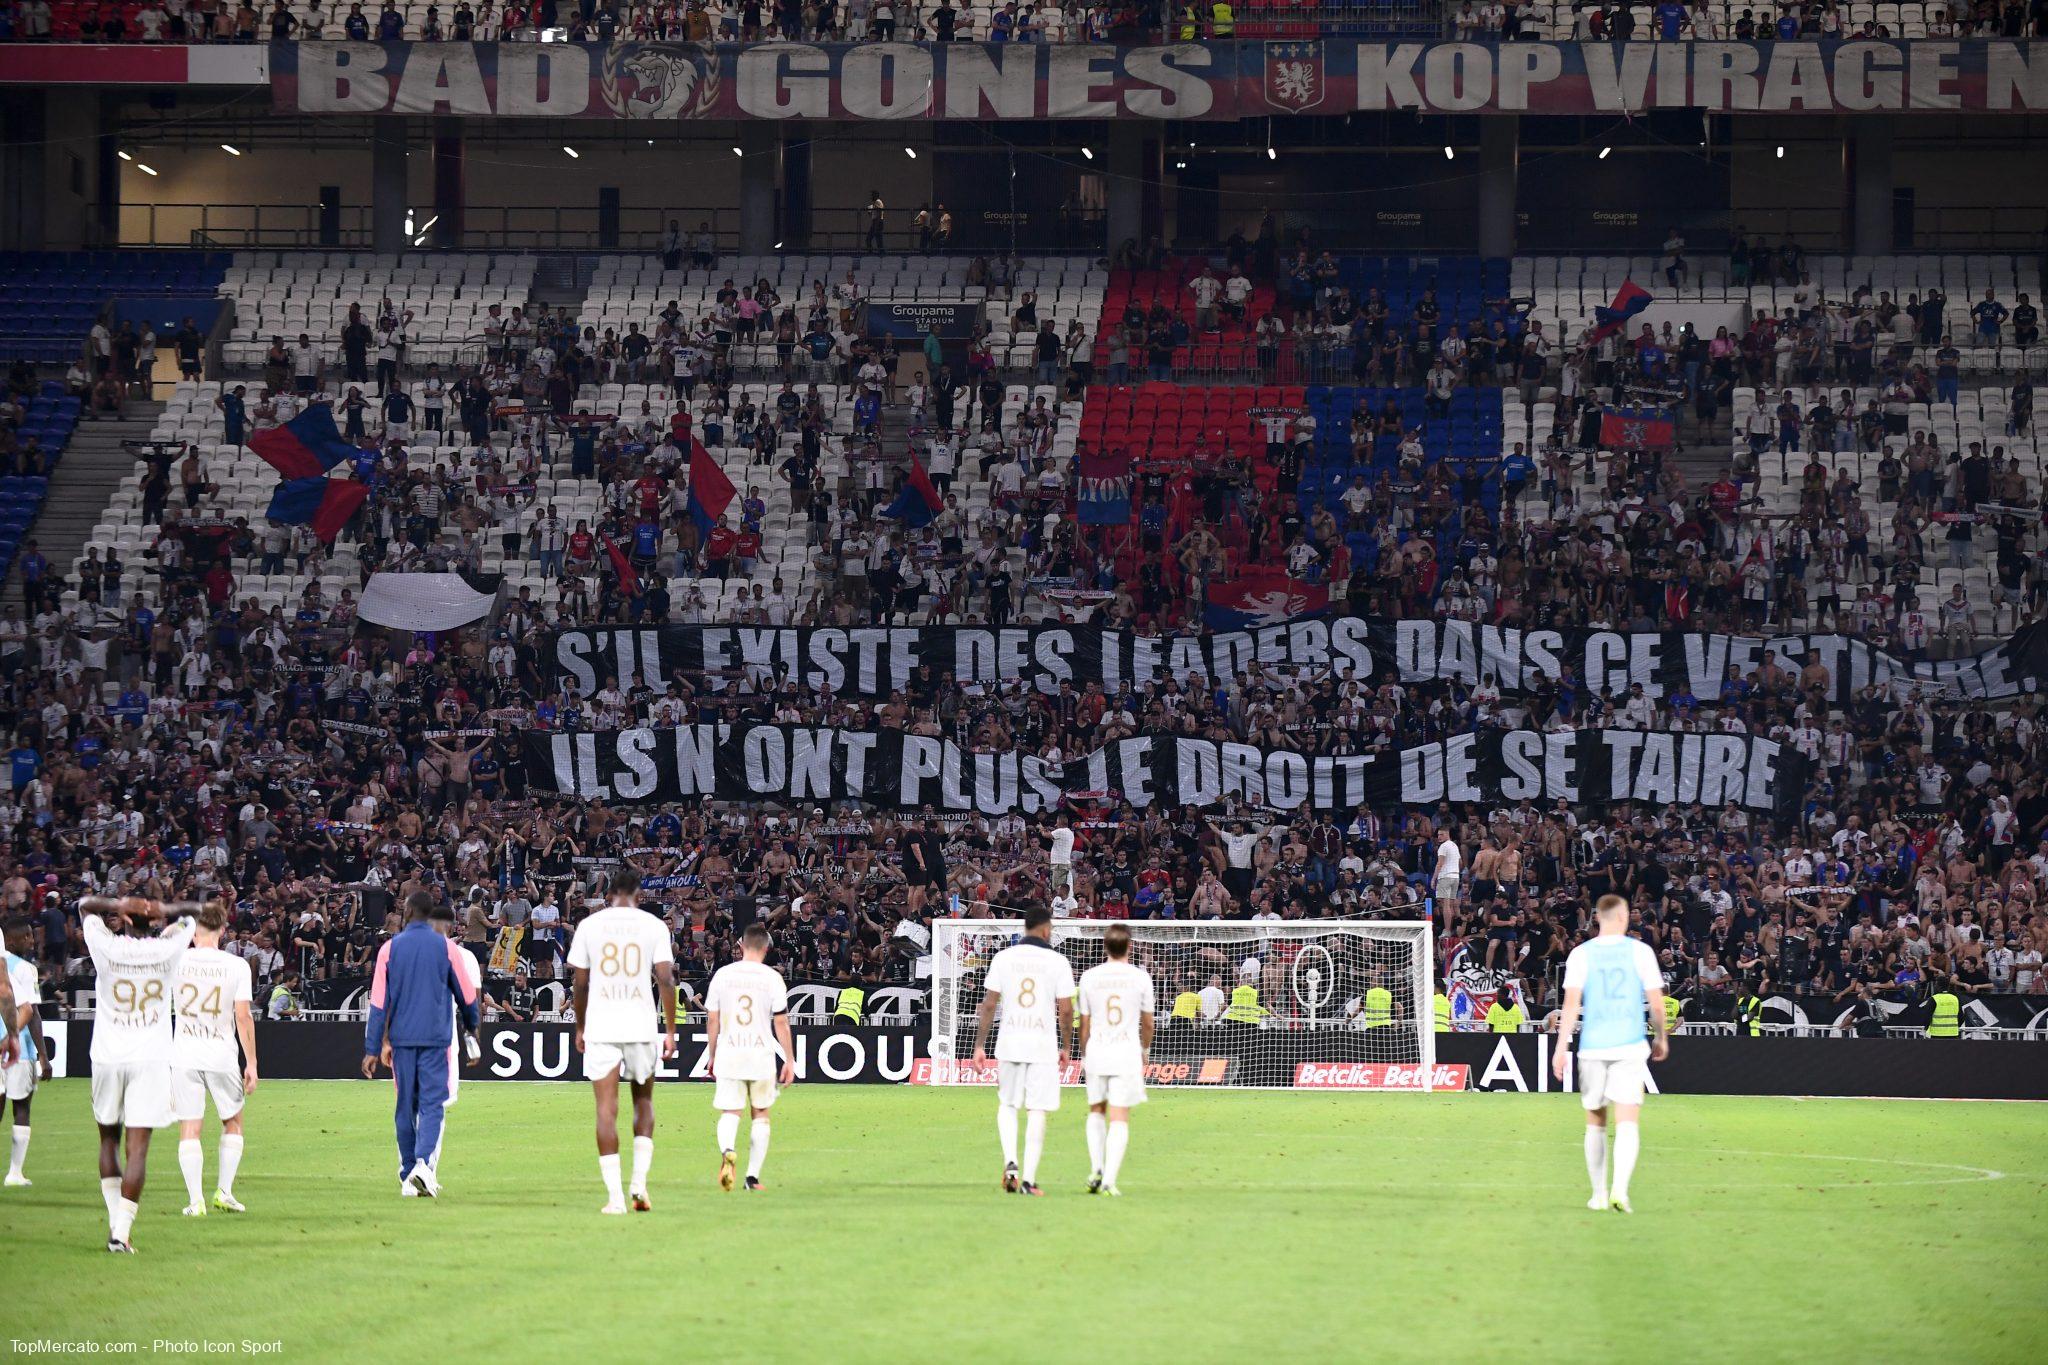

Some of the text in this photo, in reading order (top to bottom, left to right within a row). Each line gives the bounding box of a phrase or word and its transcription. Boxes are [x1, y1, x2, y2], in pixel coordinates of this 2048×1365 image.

[298, 41, 1213, 118] BAD GONES
[1357, 42, 1561, 110] KOP
[1580, 41, 1961, 111] VIRAGE
[1377, 212, 1421, 222] Groupama
[1593, 212, 1637, 222] Groupama
[893, 305, 954, 318] Groupama
[1077, 475, 1130, 503] LYON
[557, 629, 671, 699] S'IL
[703, 627, 919, 694] EXISTE
[956, 629, 1074, 695] DES
[1101, 616, 1373, 694] LEADERS
[1396, 618, 1563, 692] DANS
[1585, 632, 1664, 698] CE
[424, 729, 497, 738] BAD GONES
[552, 724, 1780, 814] ILS N'ONT PLUS LE DROIT DE SE TAIRE
[898, 813, 970, 821] VIRE NORD
[1083, 821, 1119, 830] LYON
[600, 942, 641, 977] 80
[113, 978, 163, 1012] 98
[1018, 977, 1035, 1009] 8
[1598, 967, 1626, 999] 12
[180, 983, 221, 1019] 24
[736, 994, 752, 1026] 3
[1106, 995, 1122, 1026] 6
[1298, 1064, 1373, 1086] Betclic
